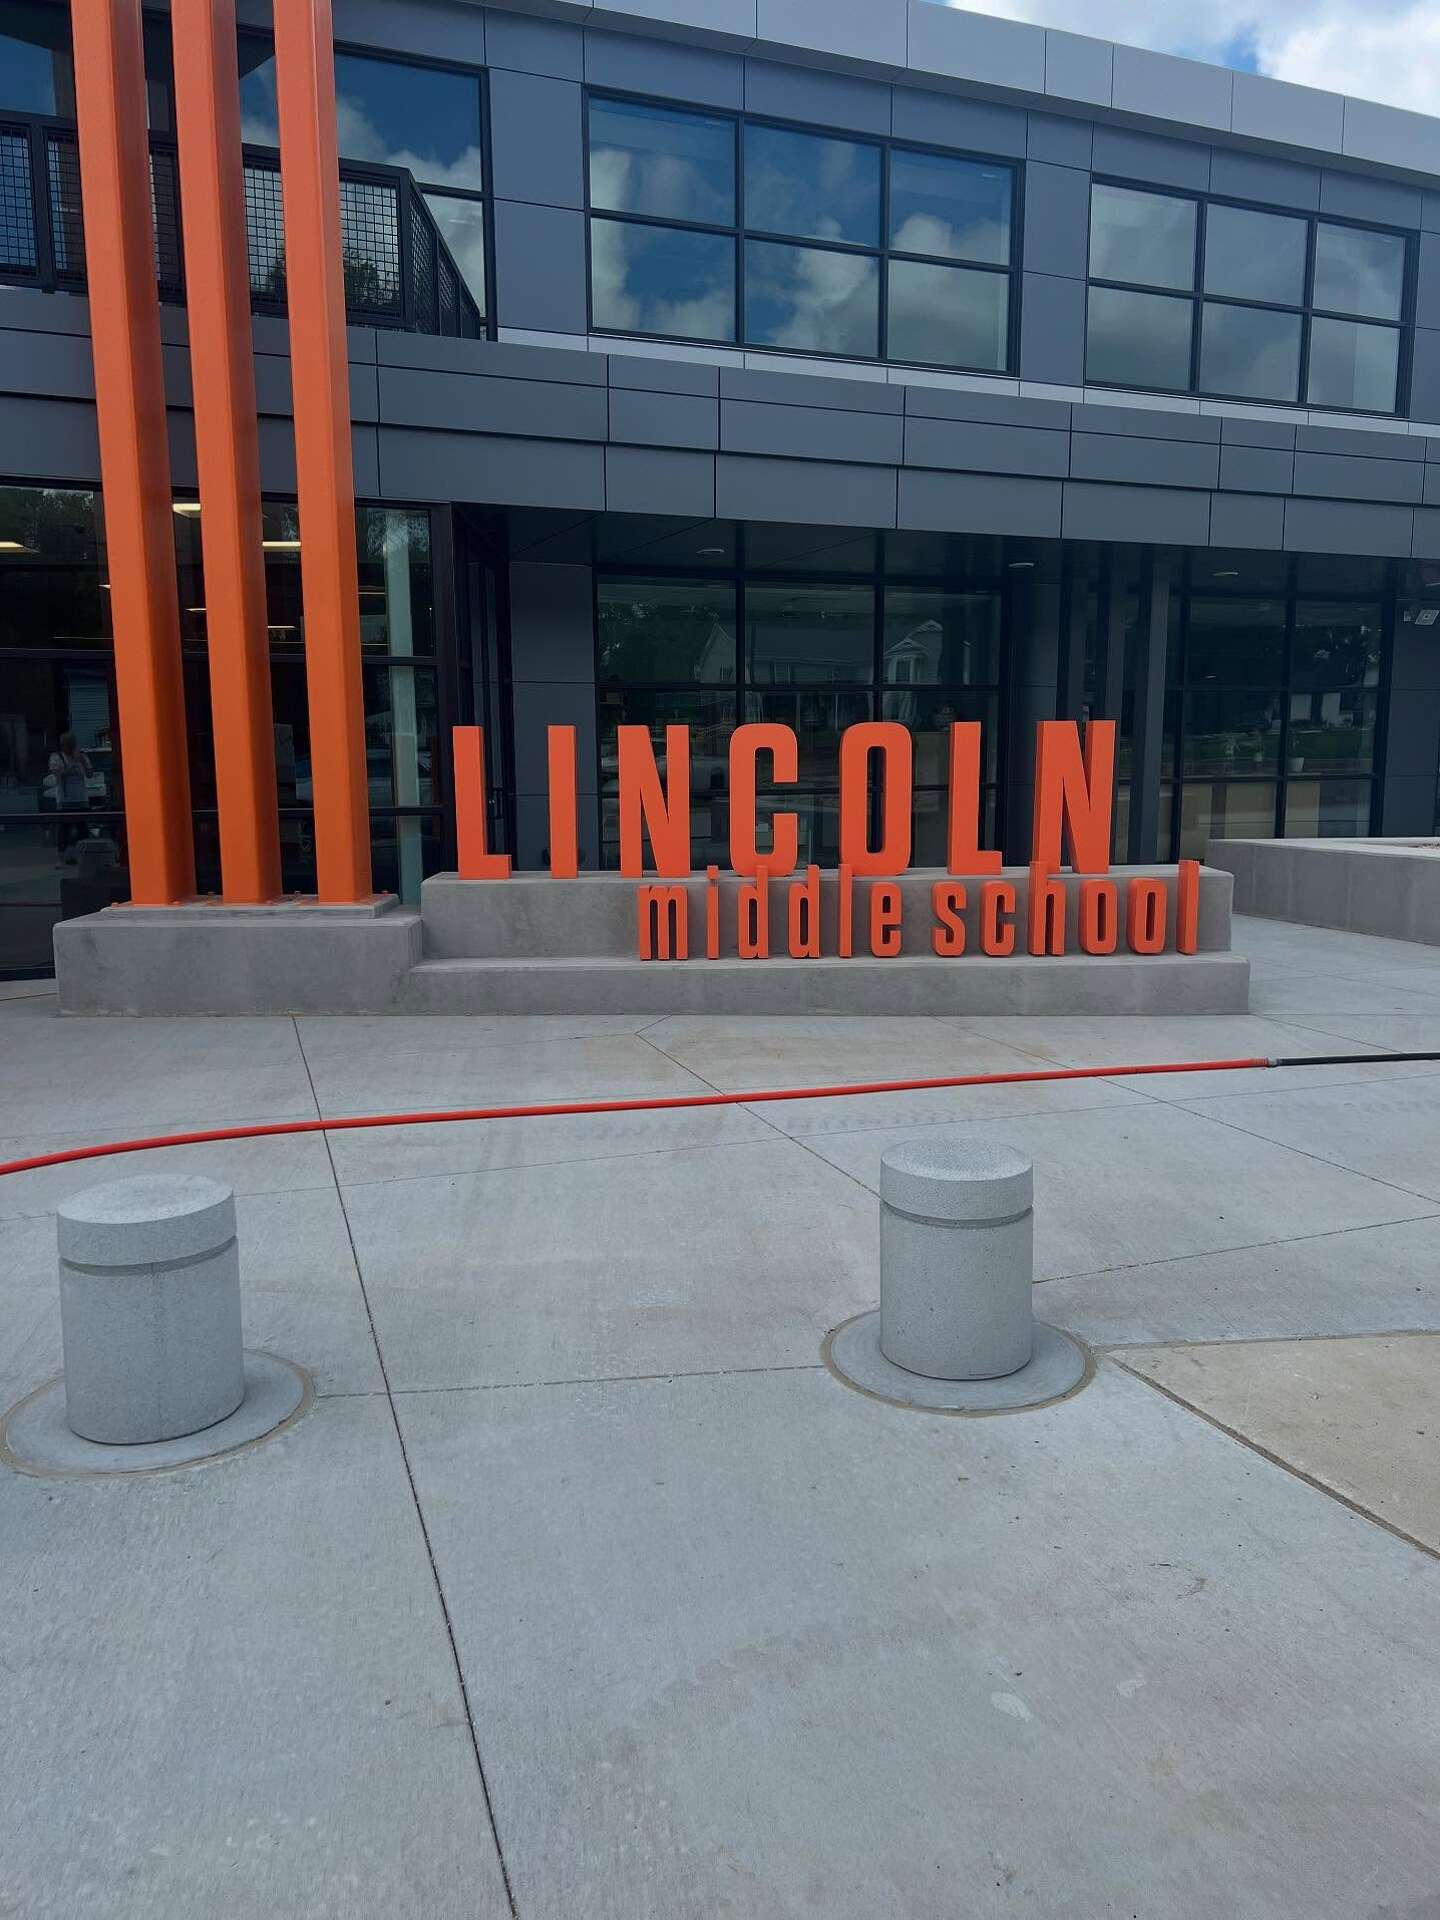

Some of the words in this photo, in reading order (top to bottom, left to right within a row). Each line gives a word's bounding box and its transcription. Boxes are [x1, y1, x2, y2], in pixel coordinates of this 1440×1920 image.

[451, 720, 1116, 880] LINCOLN
[638, 863, 903, 961] middle
[931, 860, 1201, 957] school
